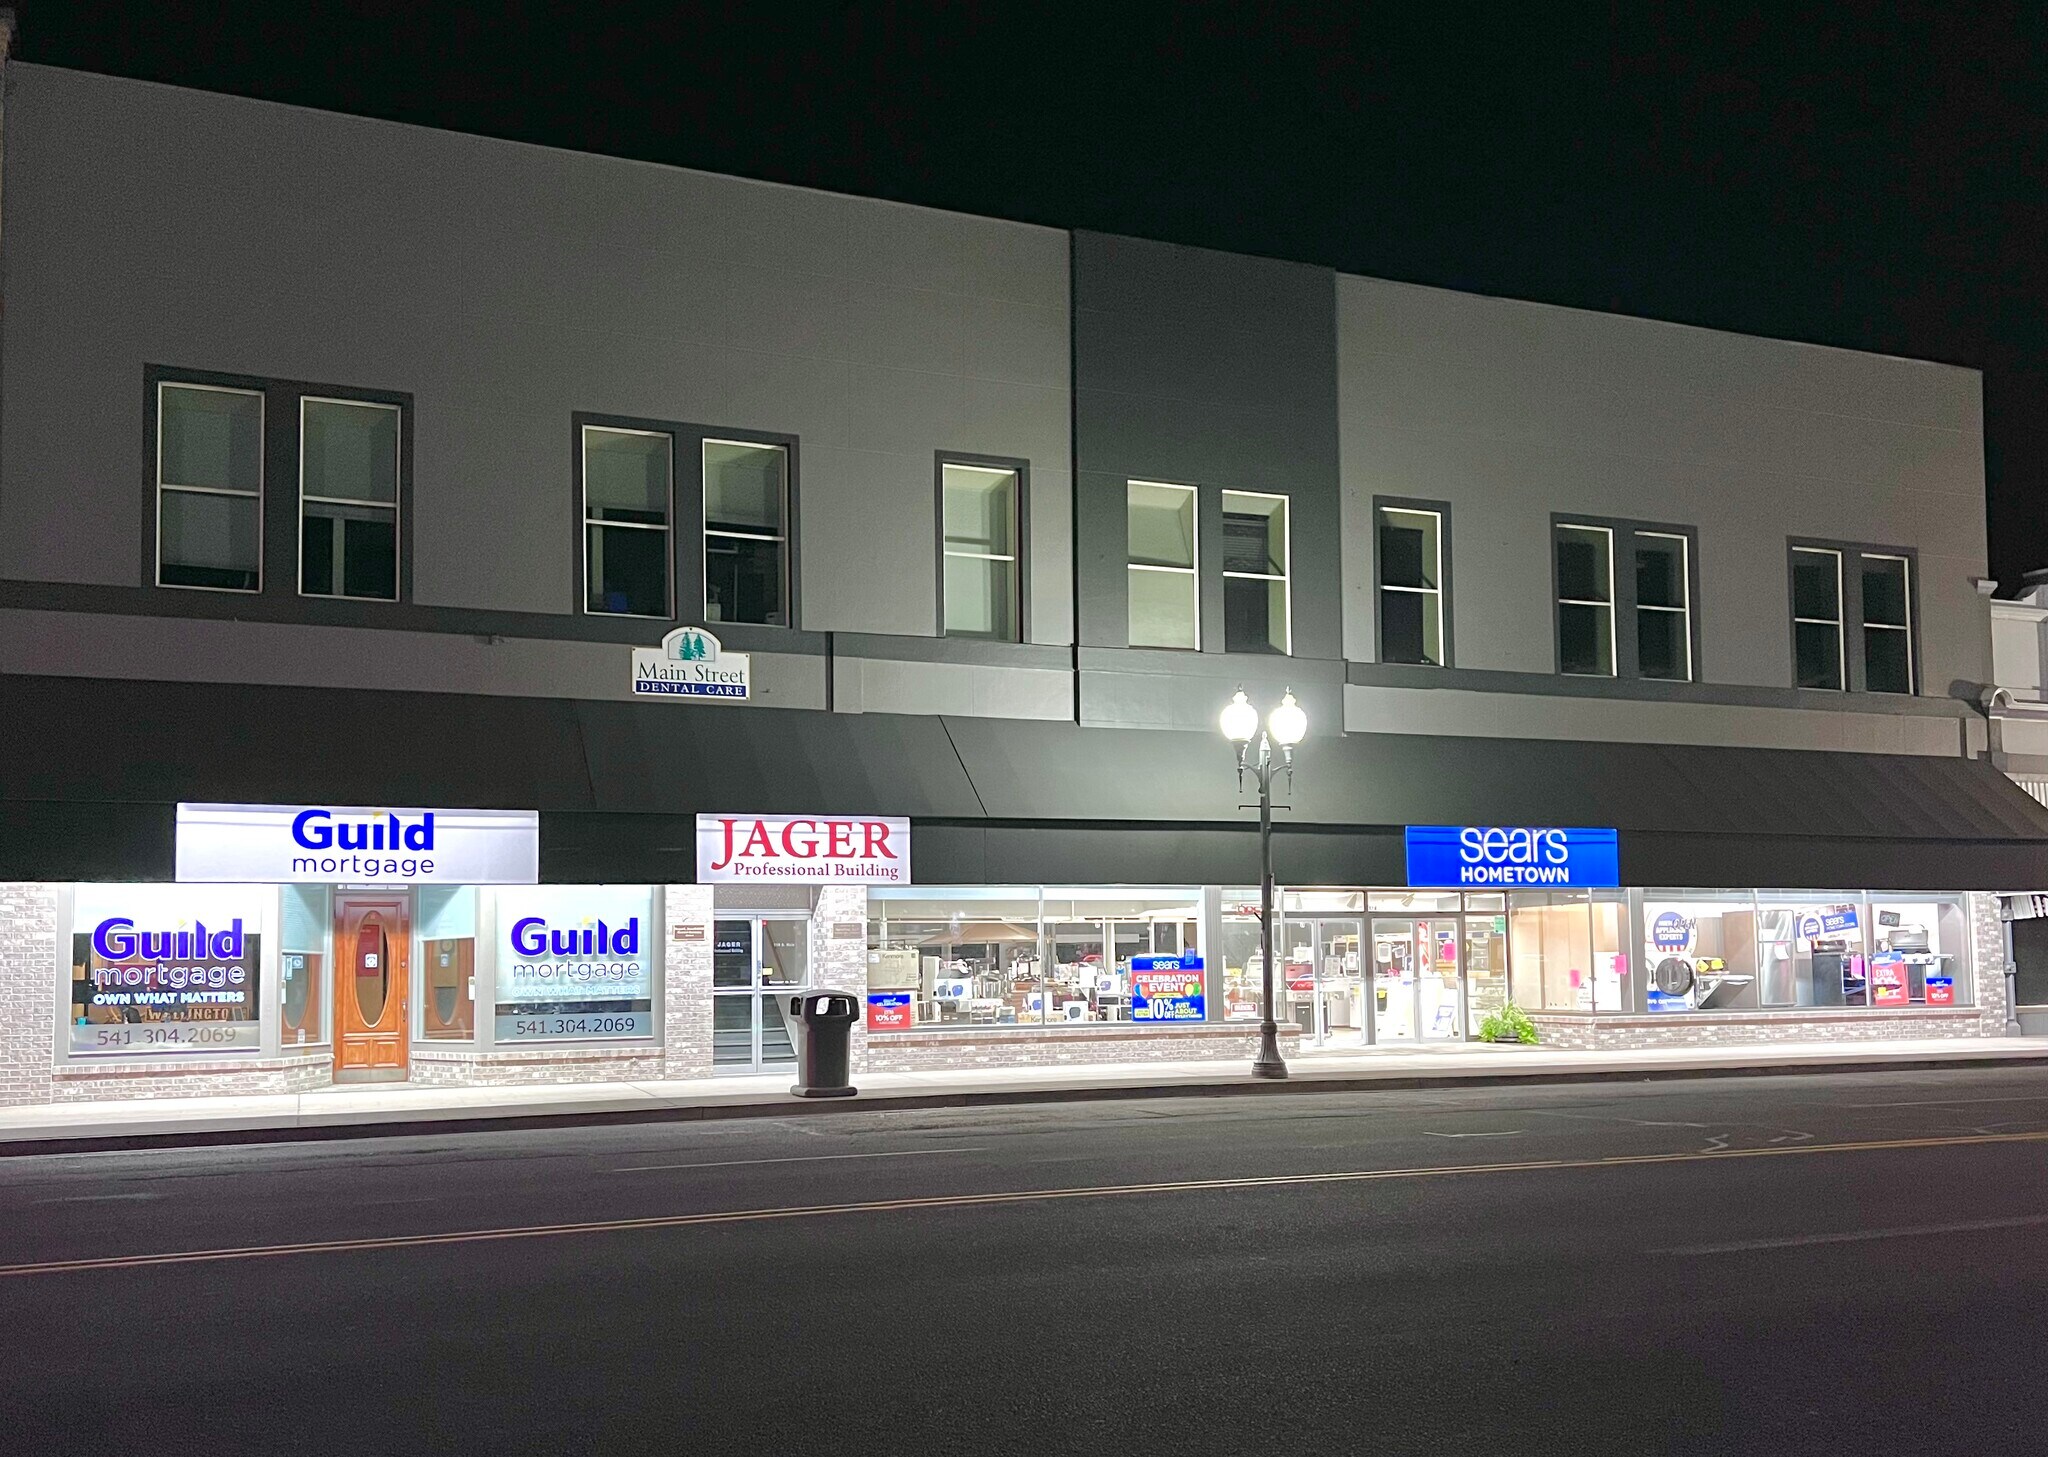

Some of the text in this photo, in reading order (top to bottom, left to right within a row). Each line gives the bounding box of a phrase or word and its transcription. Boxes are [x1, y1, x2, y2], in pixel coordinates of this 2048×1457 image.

[638, 662, 745, 683] Main Street
[640, 682, 743, 695] DENTAL CARE
[292, 809, 434, 851] Guild
[711, 819, 898, 870] JAGER
[1460, 827, 1568, 864] sears
[293, 855, 434, 877] mortgage
[734, 862, 899, 881] Professional Building
[1461, 866, 1569, 883] HOMETOWN
[1826, 915, 1845, 926] sears
[93, 917, 244, 961] Guild
[511, 917, 638, 956] Guild
[513, 961, 640, 980] mortgage
[1153, 960, 1180, 970] sears
[94, 963, 246, 989] mortgage
[1136, 974, 1199, 983] CELEBRATION
[1149, 982, 1185, 992] EVENT
[93, 991, 245, 1005] OWN WHAT MATTERS
[516, 1017, 635, 1035] 541.304.2069
[97, 1028, 236, 1046] 541.304.2069
